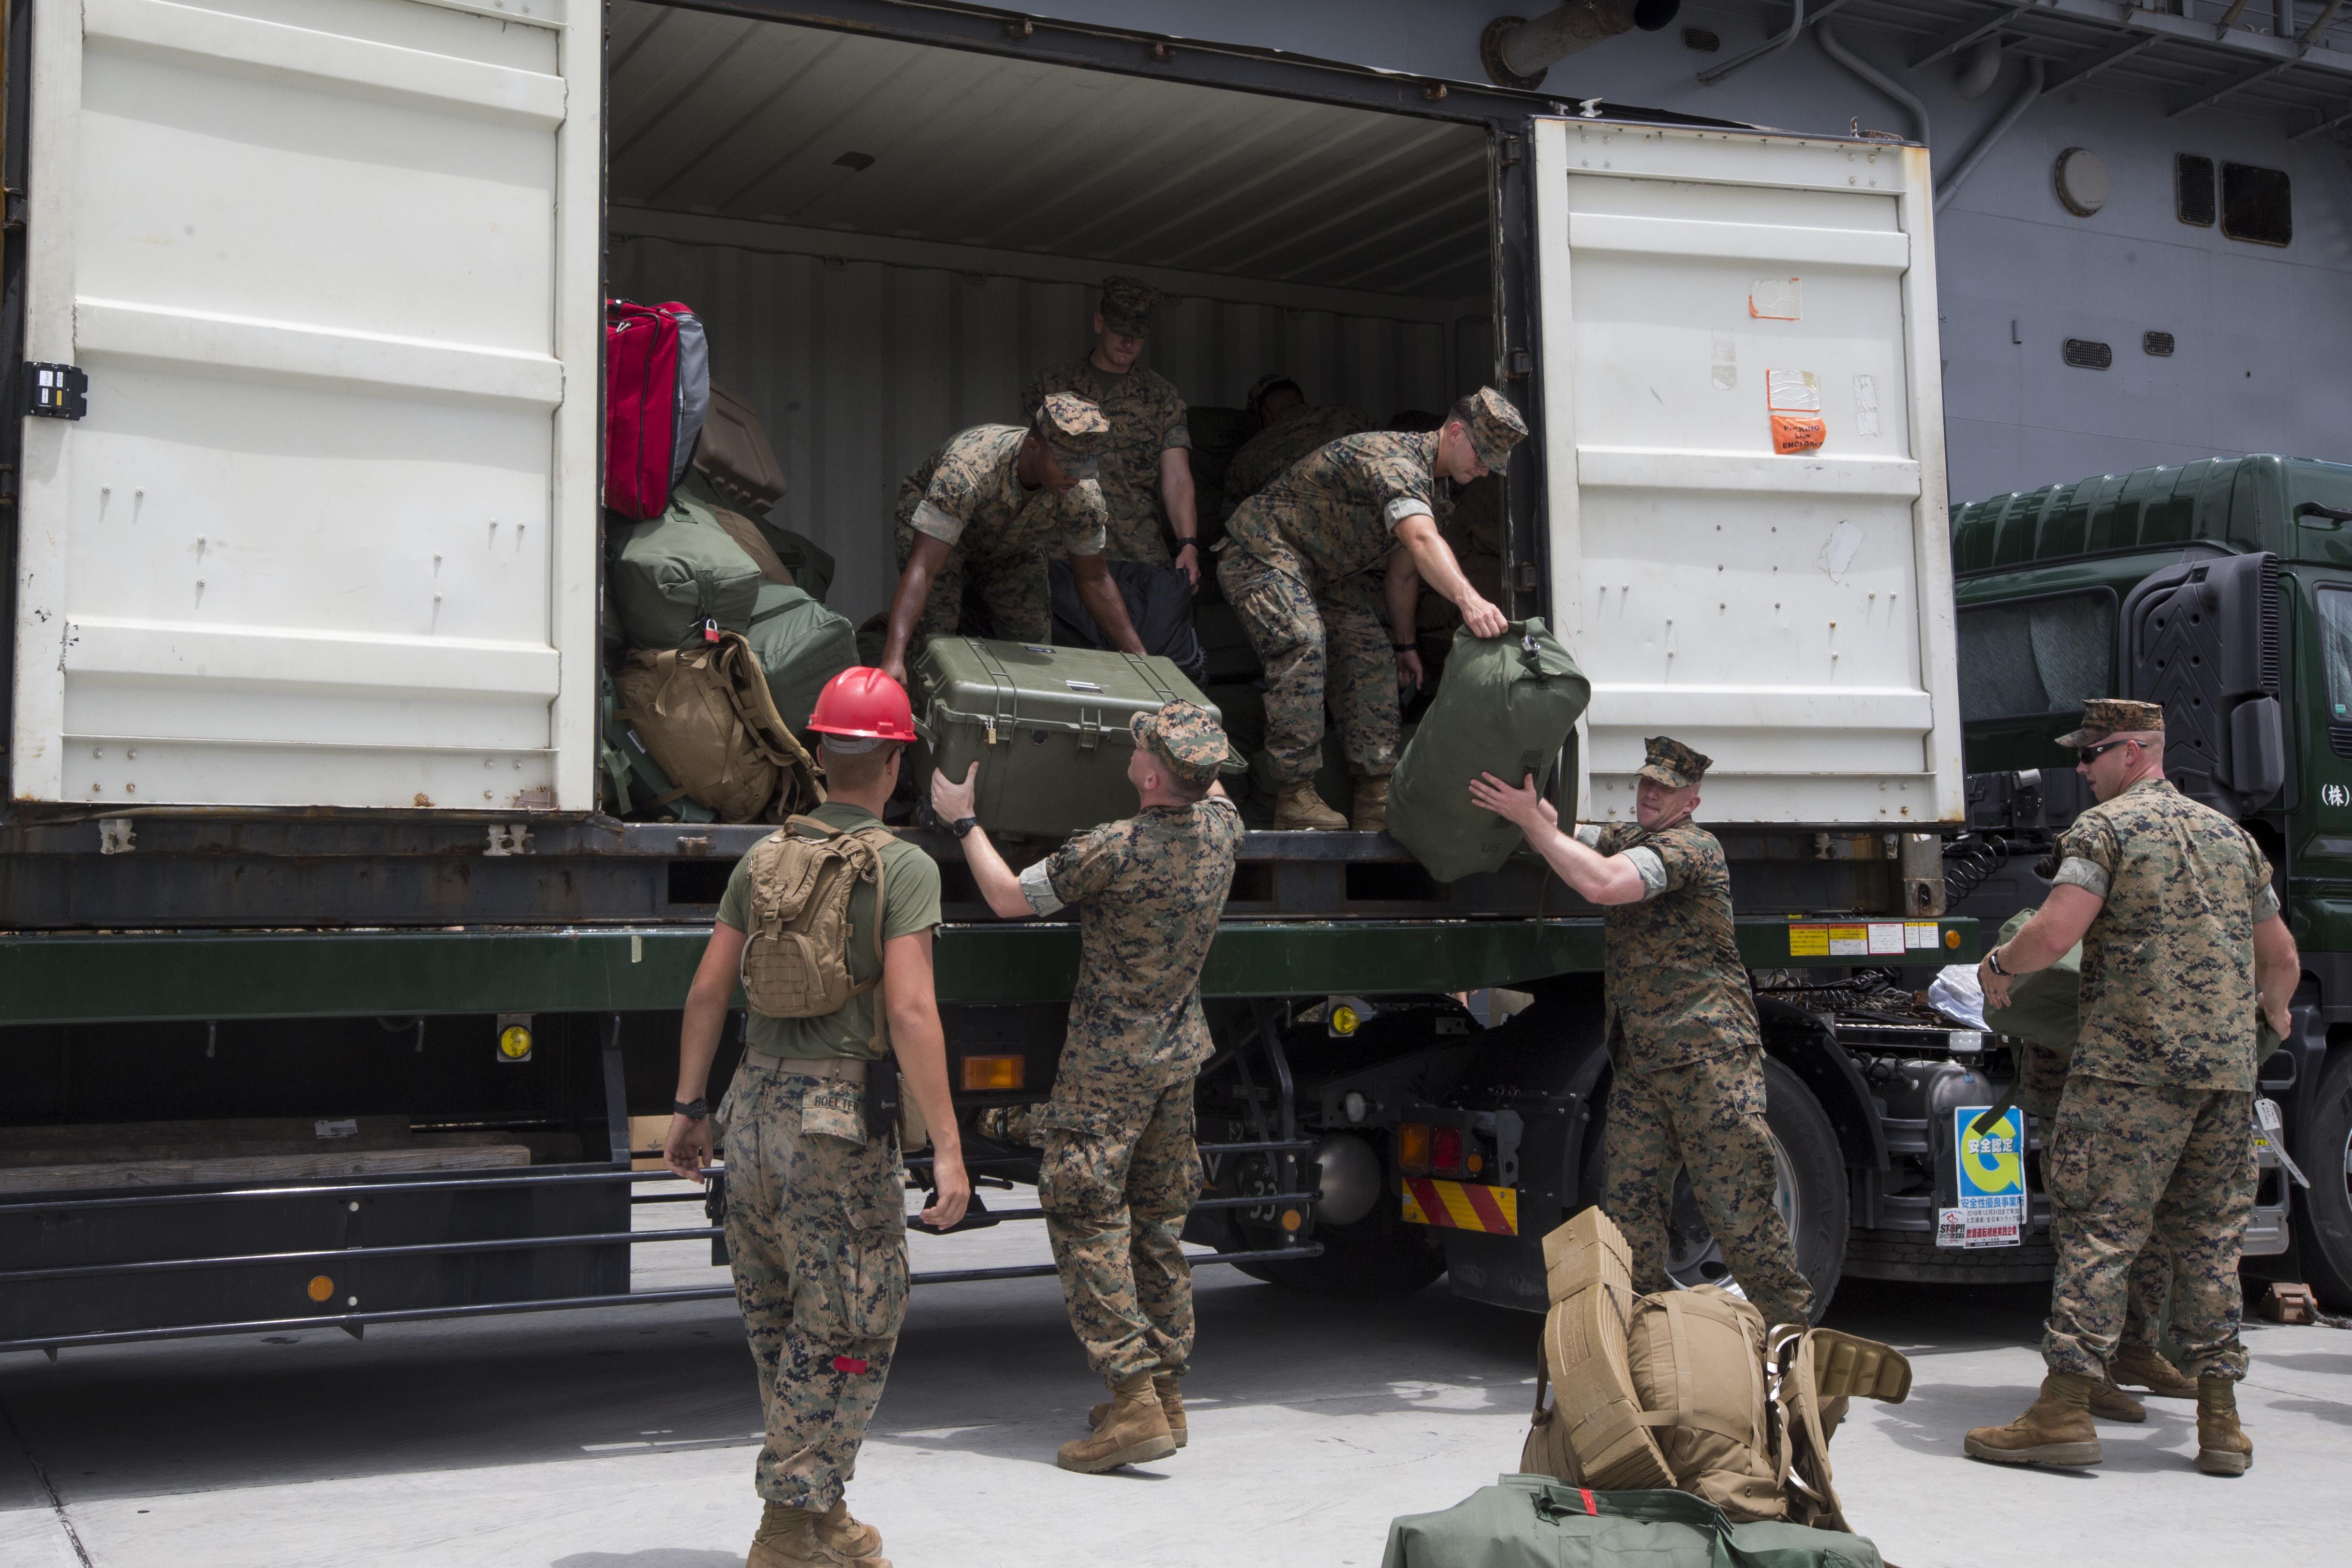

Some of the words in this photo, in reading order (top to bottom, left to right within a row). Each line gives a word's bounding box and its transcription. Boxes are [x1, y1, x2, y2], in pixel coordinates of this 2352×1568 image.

[814, 1096, 859, 1112] BOELTER
[1968, 1138, 2013, 1154] 安全認定
[1961, 1197, 2025, 1208] 安全性優良事業所
[1940, 1224, 1965, 1233] STOP!!
